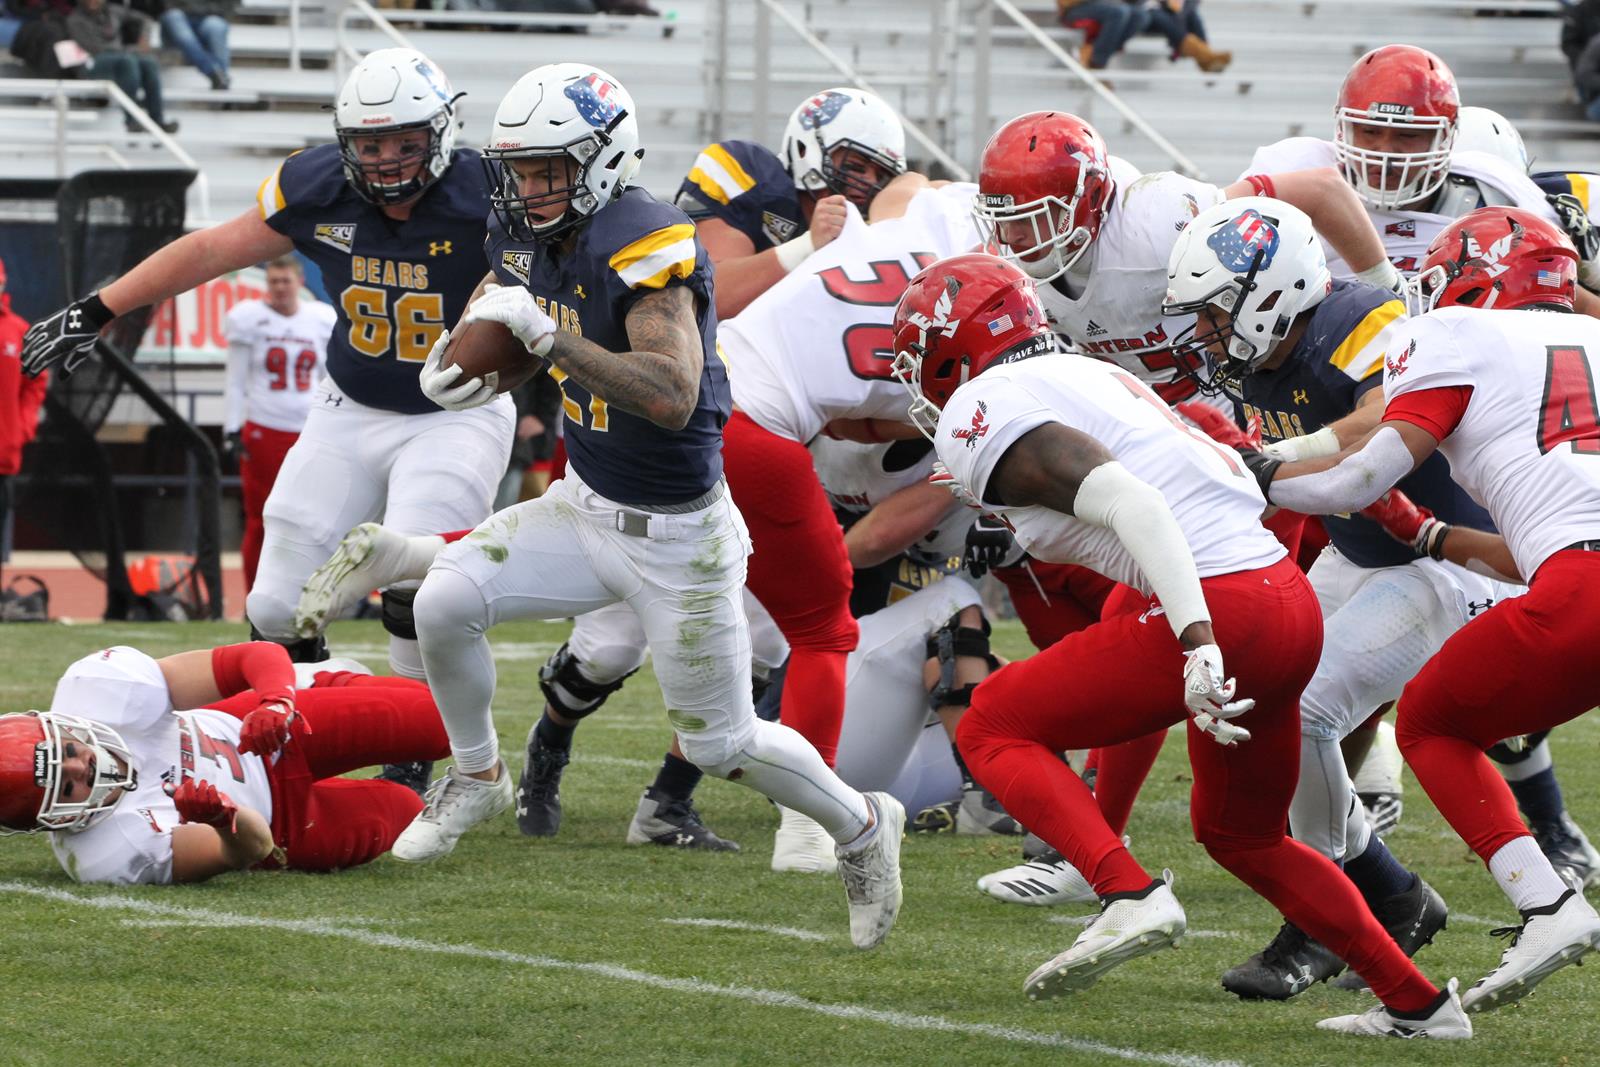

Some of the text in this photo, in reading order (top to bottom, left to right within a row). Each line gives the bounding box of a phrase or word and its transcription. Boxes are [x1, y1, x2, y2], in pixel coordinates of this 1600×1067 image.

[1380, 104, 1405, 114] EWU
[1058, 212, 1071, 235] Ridde
[352, 255, 429, 290] BEARS
[340, 284, 445, 364] 66
[533, 295, 582, 337] EARS
[1003, 346, 1033, 364] LEAVE
[35, 750, 46, 777] Riddell
